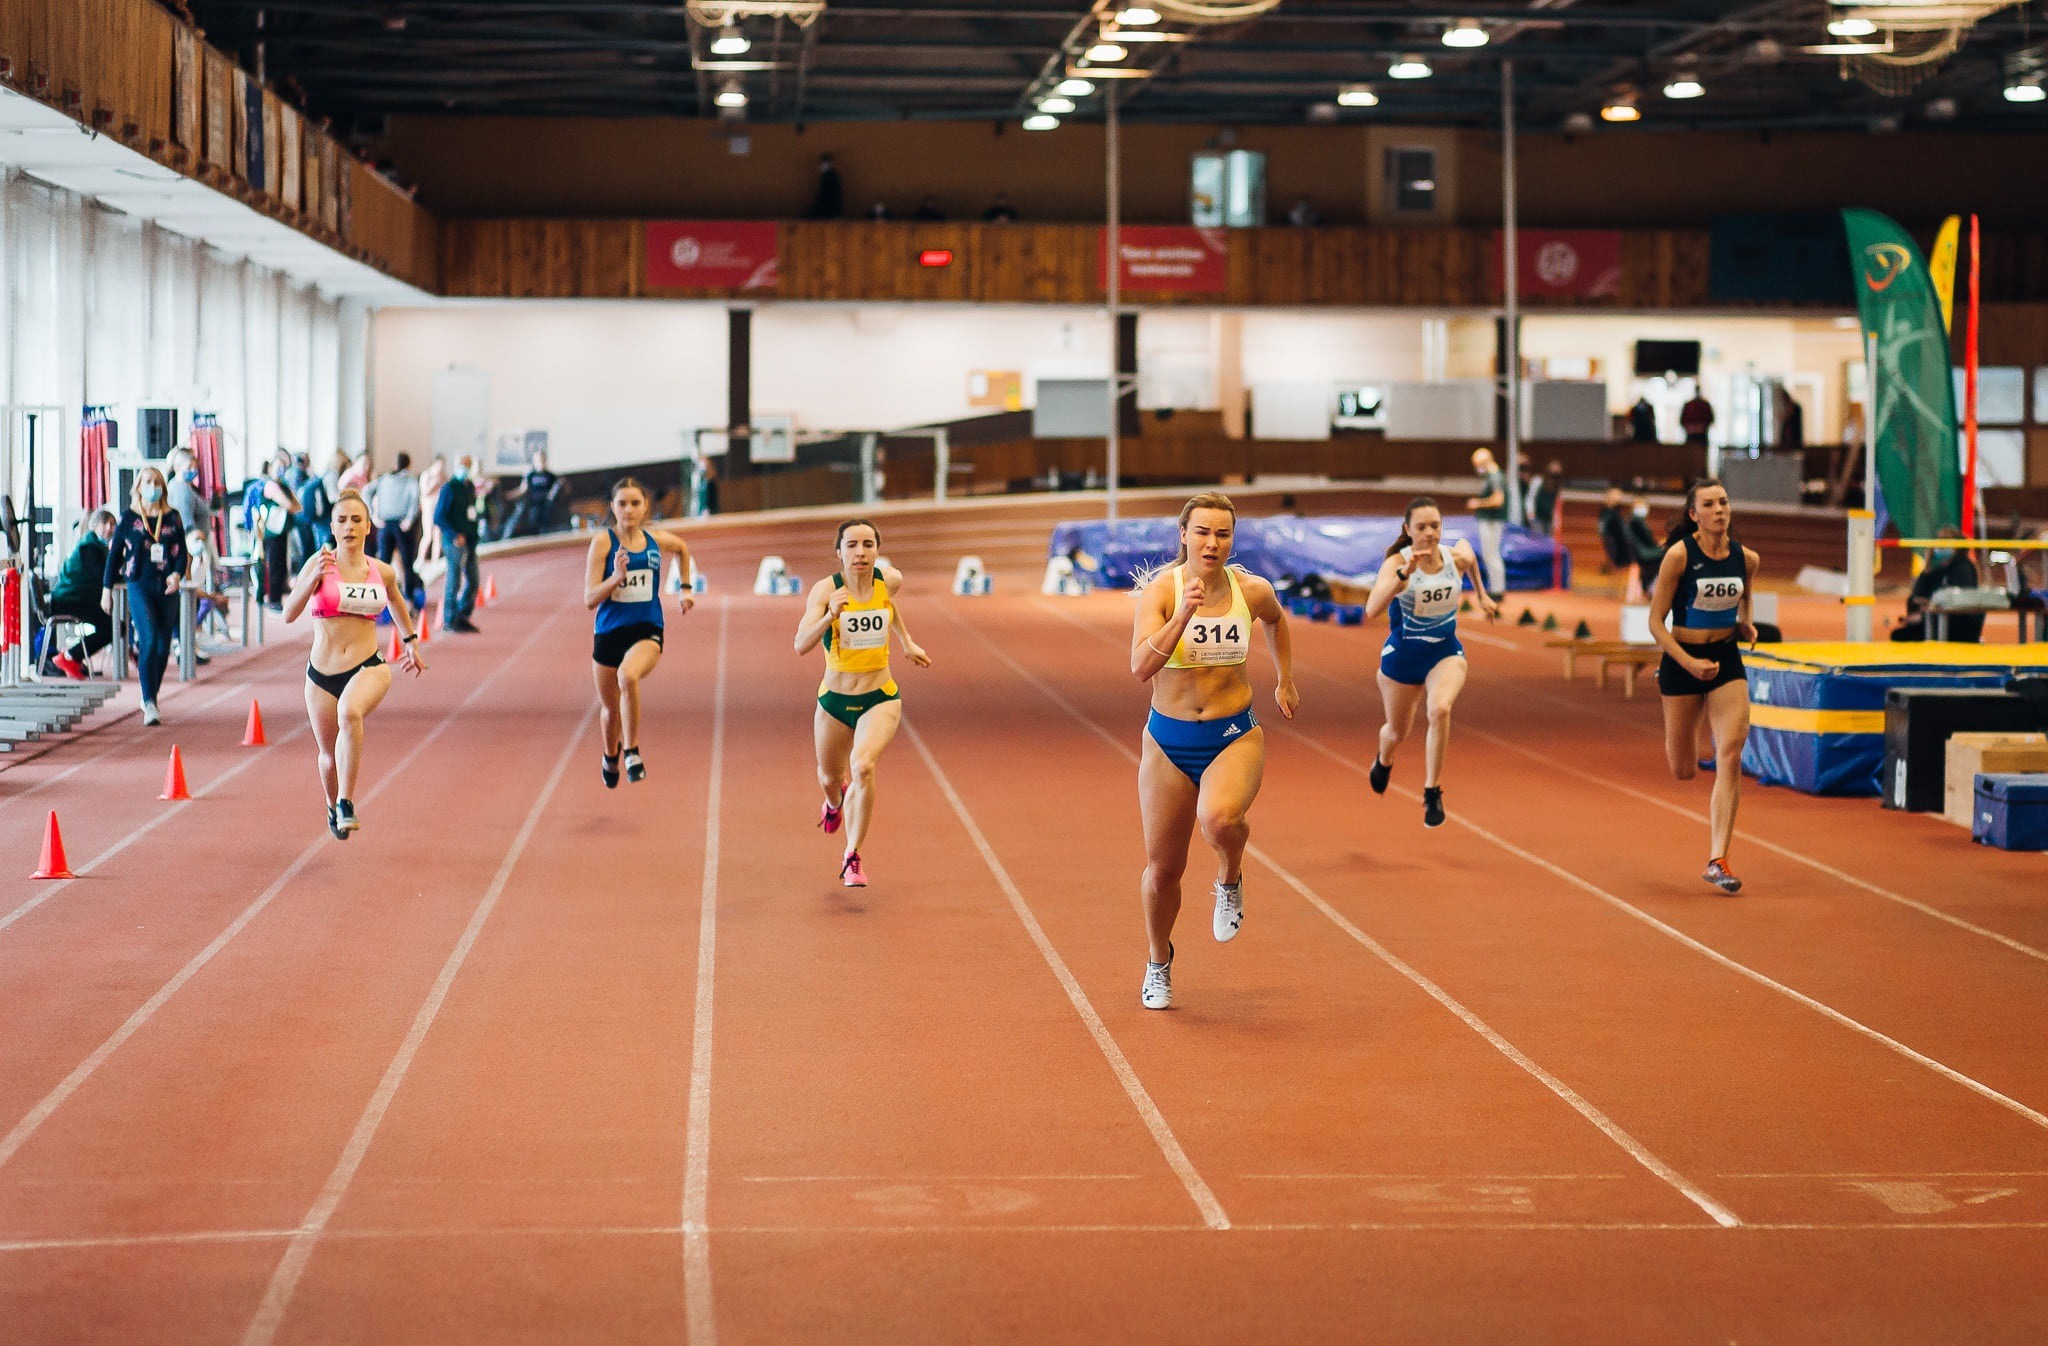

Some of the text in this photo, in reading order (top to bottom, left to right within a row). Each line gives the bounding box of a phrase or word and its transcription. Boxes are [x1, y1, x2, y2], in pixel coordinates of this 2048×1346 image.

[346, 586, 378, 601] 271
[1422, 586, 1452, 603] 367
[1704, 583, 1738, 598] 266
[847, 615, 883, 633] 390
[1193, 624, 1240, 644] 314
